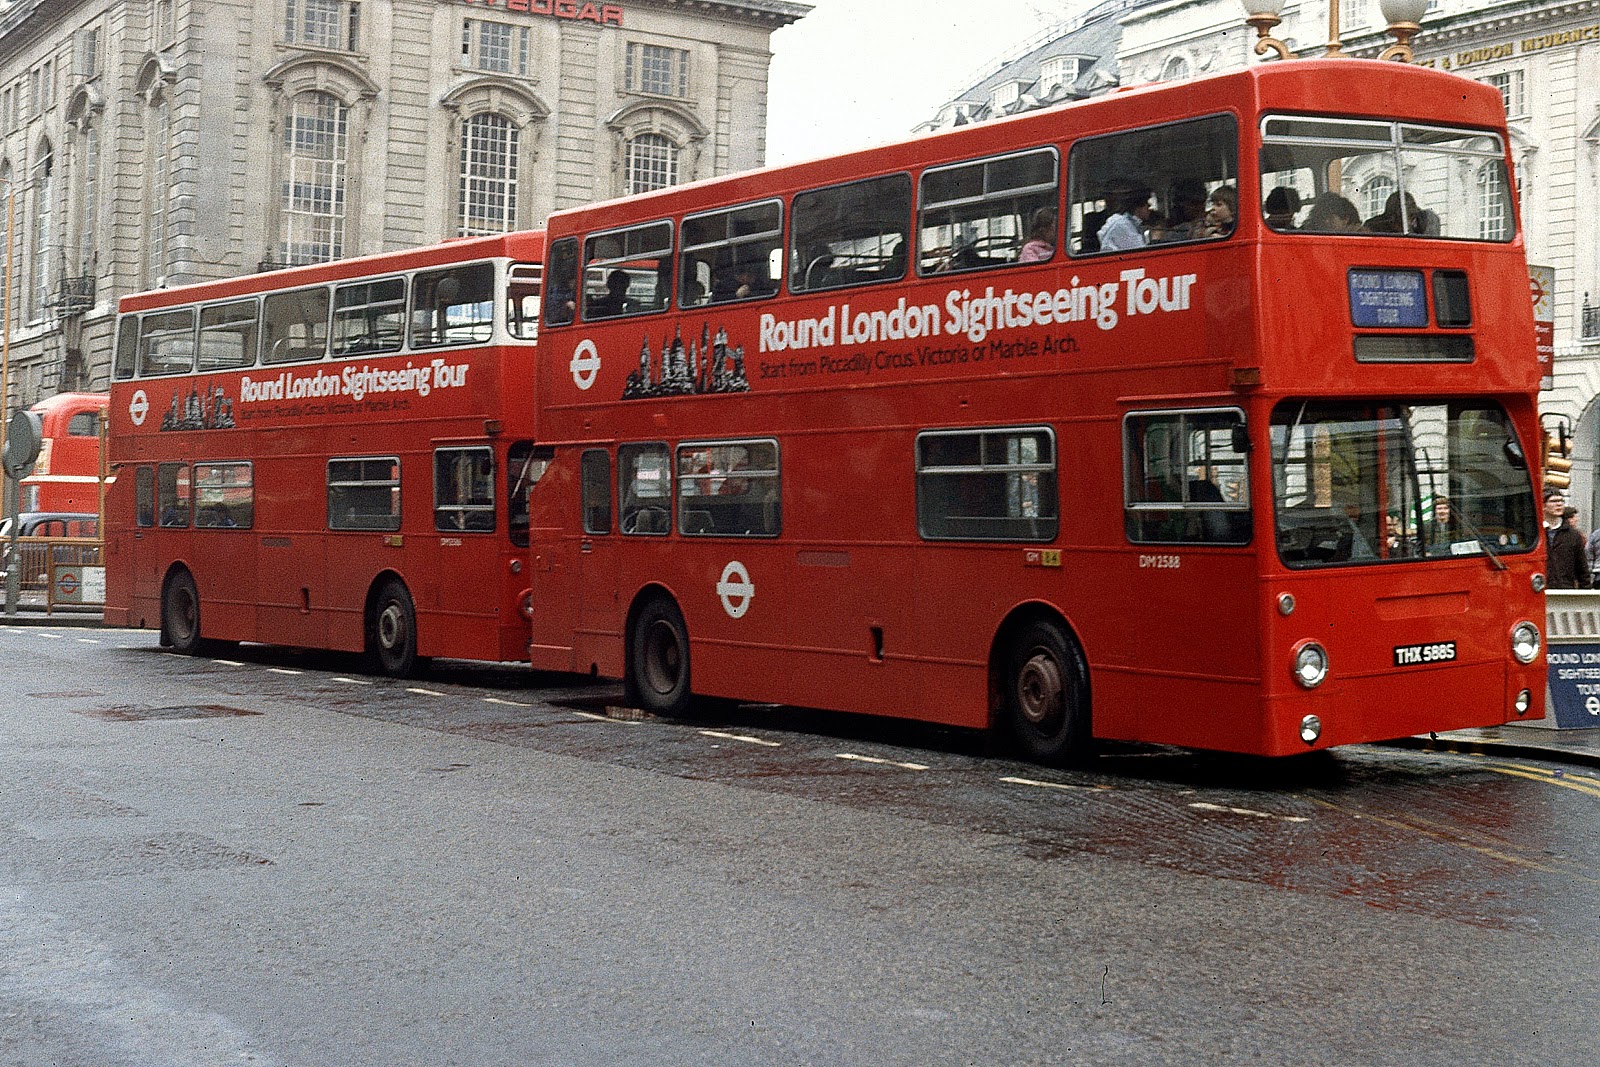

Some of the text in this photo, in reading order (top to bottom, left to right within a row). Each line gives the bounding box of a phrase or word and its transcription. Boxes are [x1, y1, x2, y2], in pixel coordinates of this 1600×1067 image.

[1456, 42, 1514, 67] LONDON
[1520, 24, 1600, 52] INSURANCE
[759, 268, 1197, 353] Round London Sightseeing Tour
[760, 361, 786, 379] Start
[789, 358, 817, 376] from
[820, 353, 871, 375] Piccadilly
[917, 343, 968, 366] Victoria
[973, 345, 985, 362] or
[989, 337, 1039, 360] Marble
[240, 358, 470, 403] Round London Sightseeing Tour
[1395, 643, 1456, 665] THX 588S
[1546, 653, 1580, 665] ROUND
